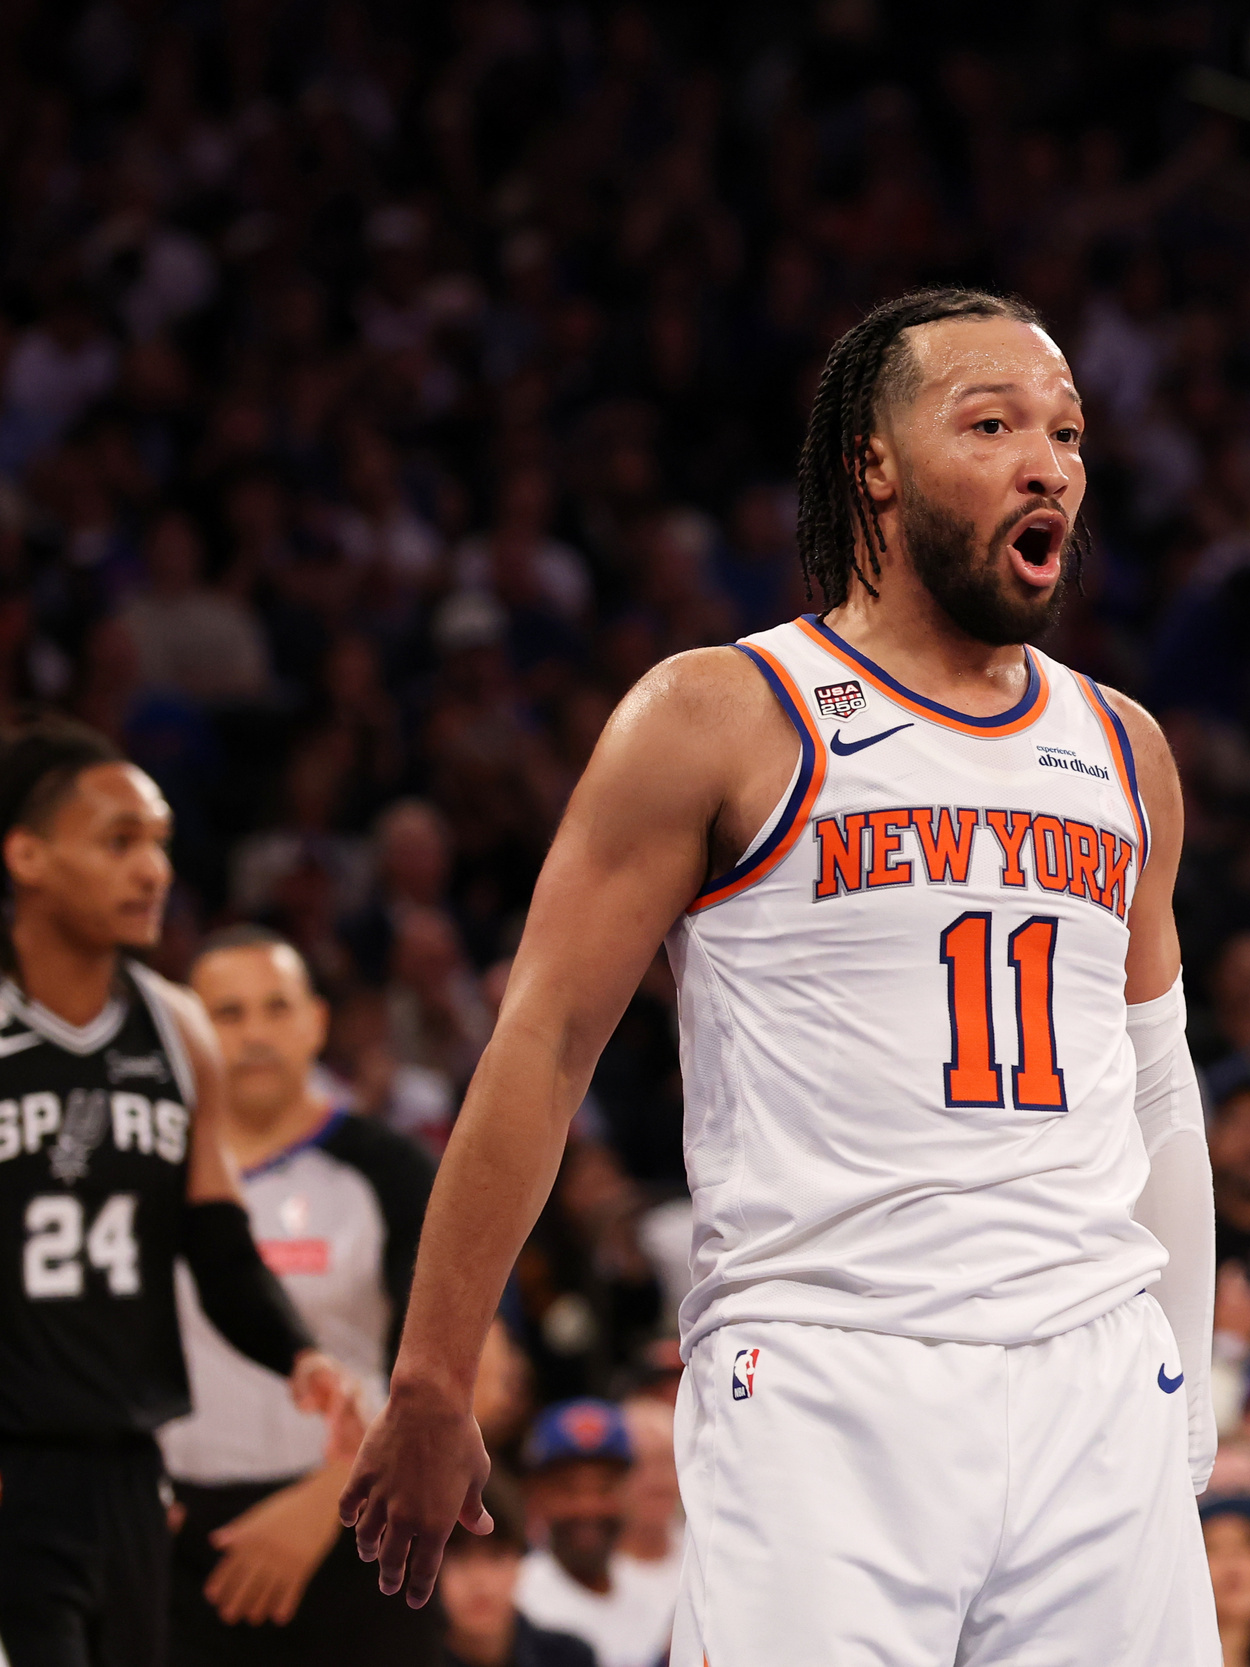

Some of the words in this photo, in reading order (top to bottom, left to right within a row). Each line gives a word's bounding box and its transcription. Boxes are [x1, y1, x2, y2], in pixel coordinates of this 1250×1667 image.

[817, 684, 860, 699] USA
[820, 698, 866, 715] 250
[1036, 744, 1077, 757] experience
[1038, 754, 1069, 770] abu
[1069, 758, 1110, 781] dhabi
[813, 806, 978, 902] NEW
[984, 806, 1133, 920] YORK
[939, 911, 1068, 1112] 11
[23, 1196, 140, 1299] 24
